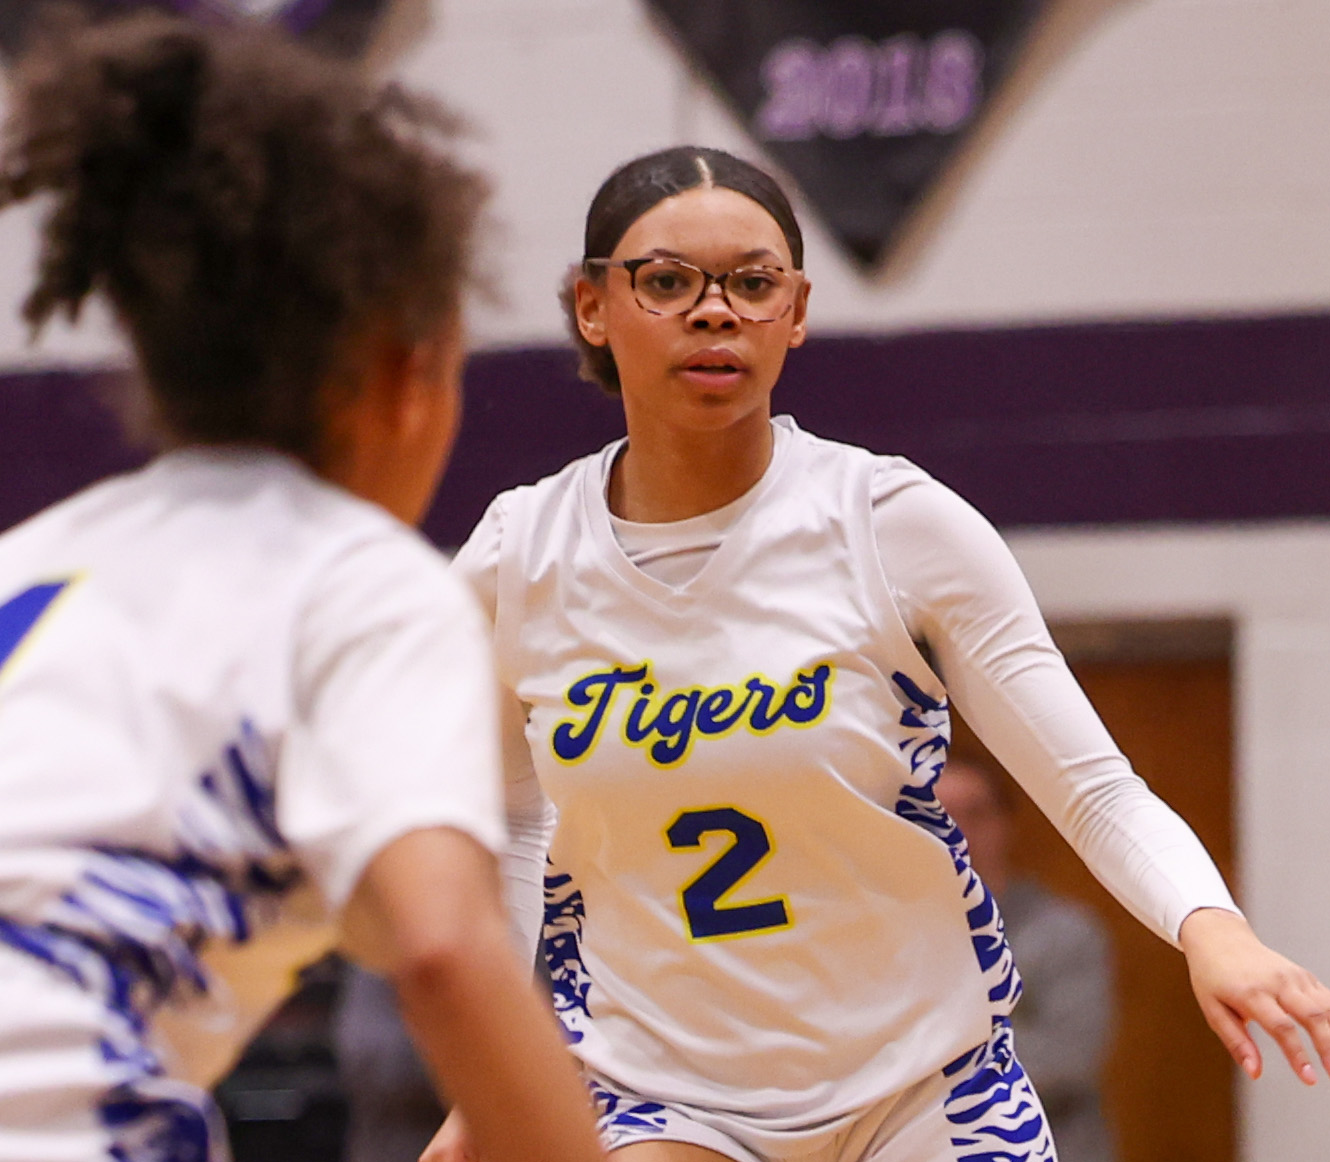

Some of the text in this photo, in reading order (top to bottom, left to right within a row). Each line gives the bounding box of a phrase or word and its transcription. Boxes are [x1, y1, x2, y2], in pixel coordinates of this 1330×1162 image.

[760, 36, 984, 140] 2018
[552, 660, 832, 769] Tigers
[661, 805, 795, 943] 2
